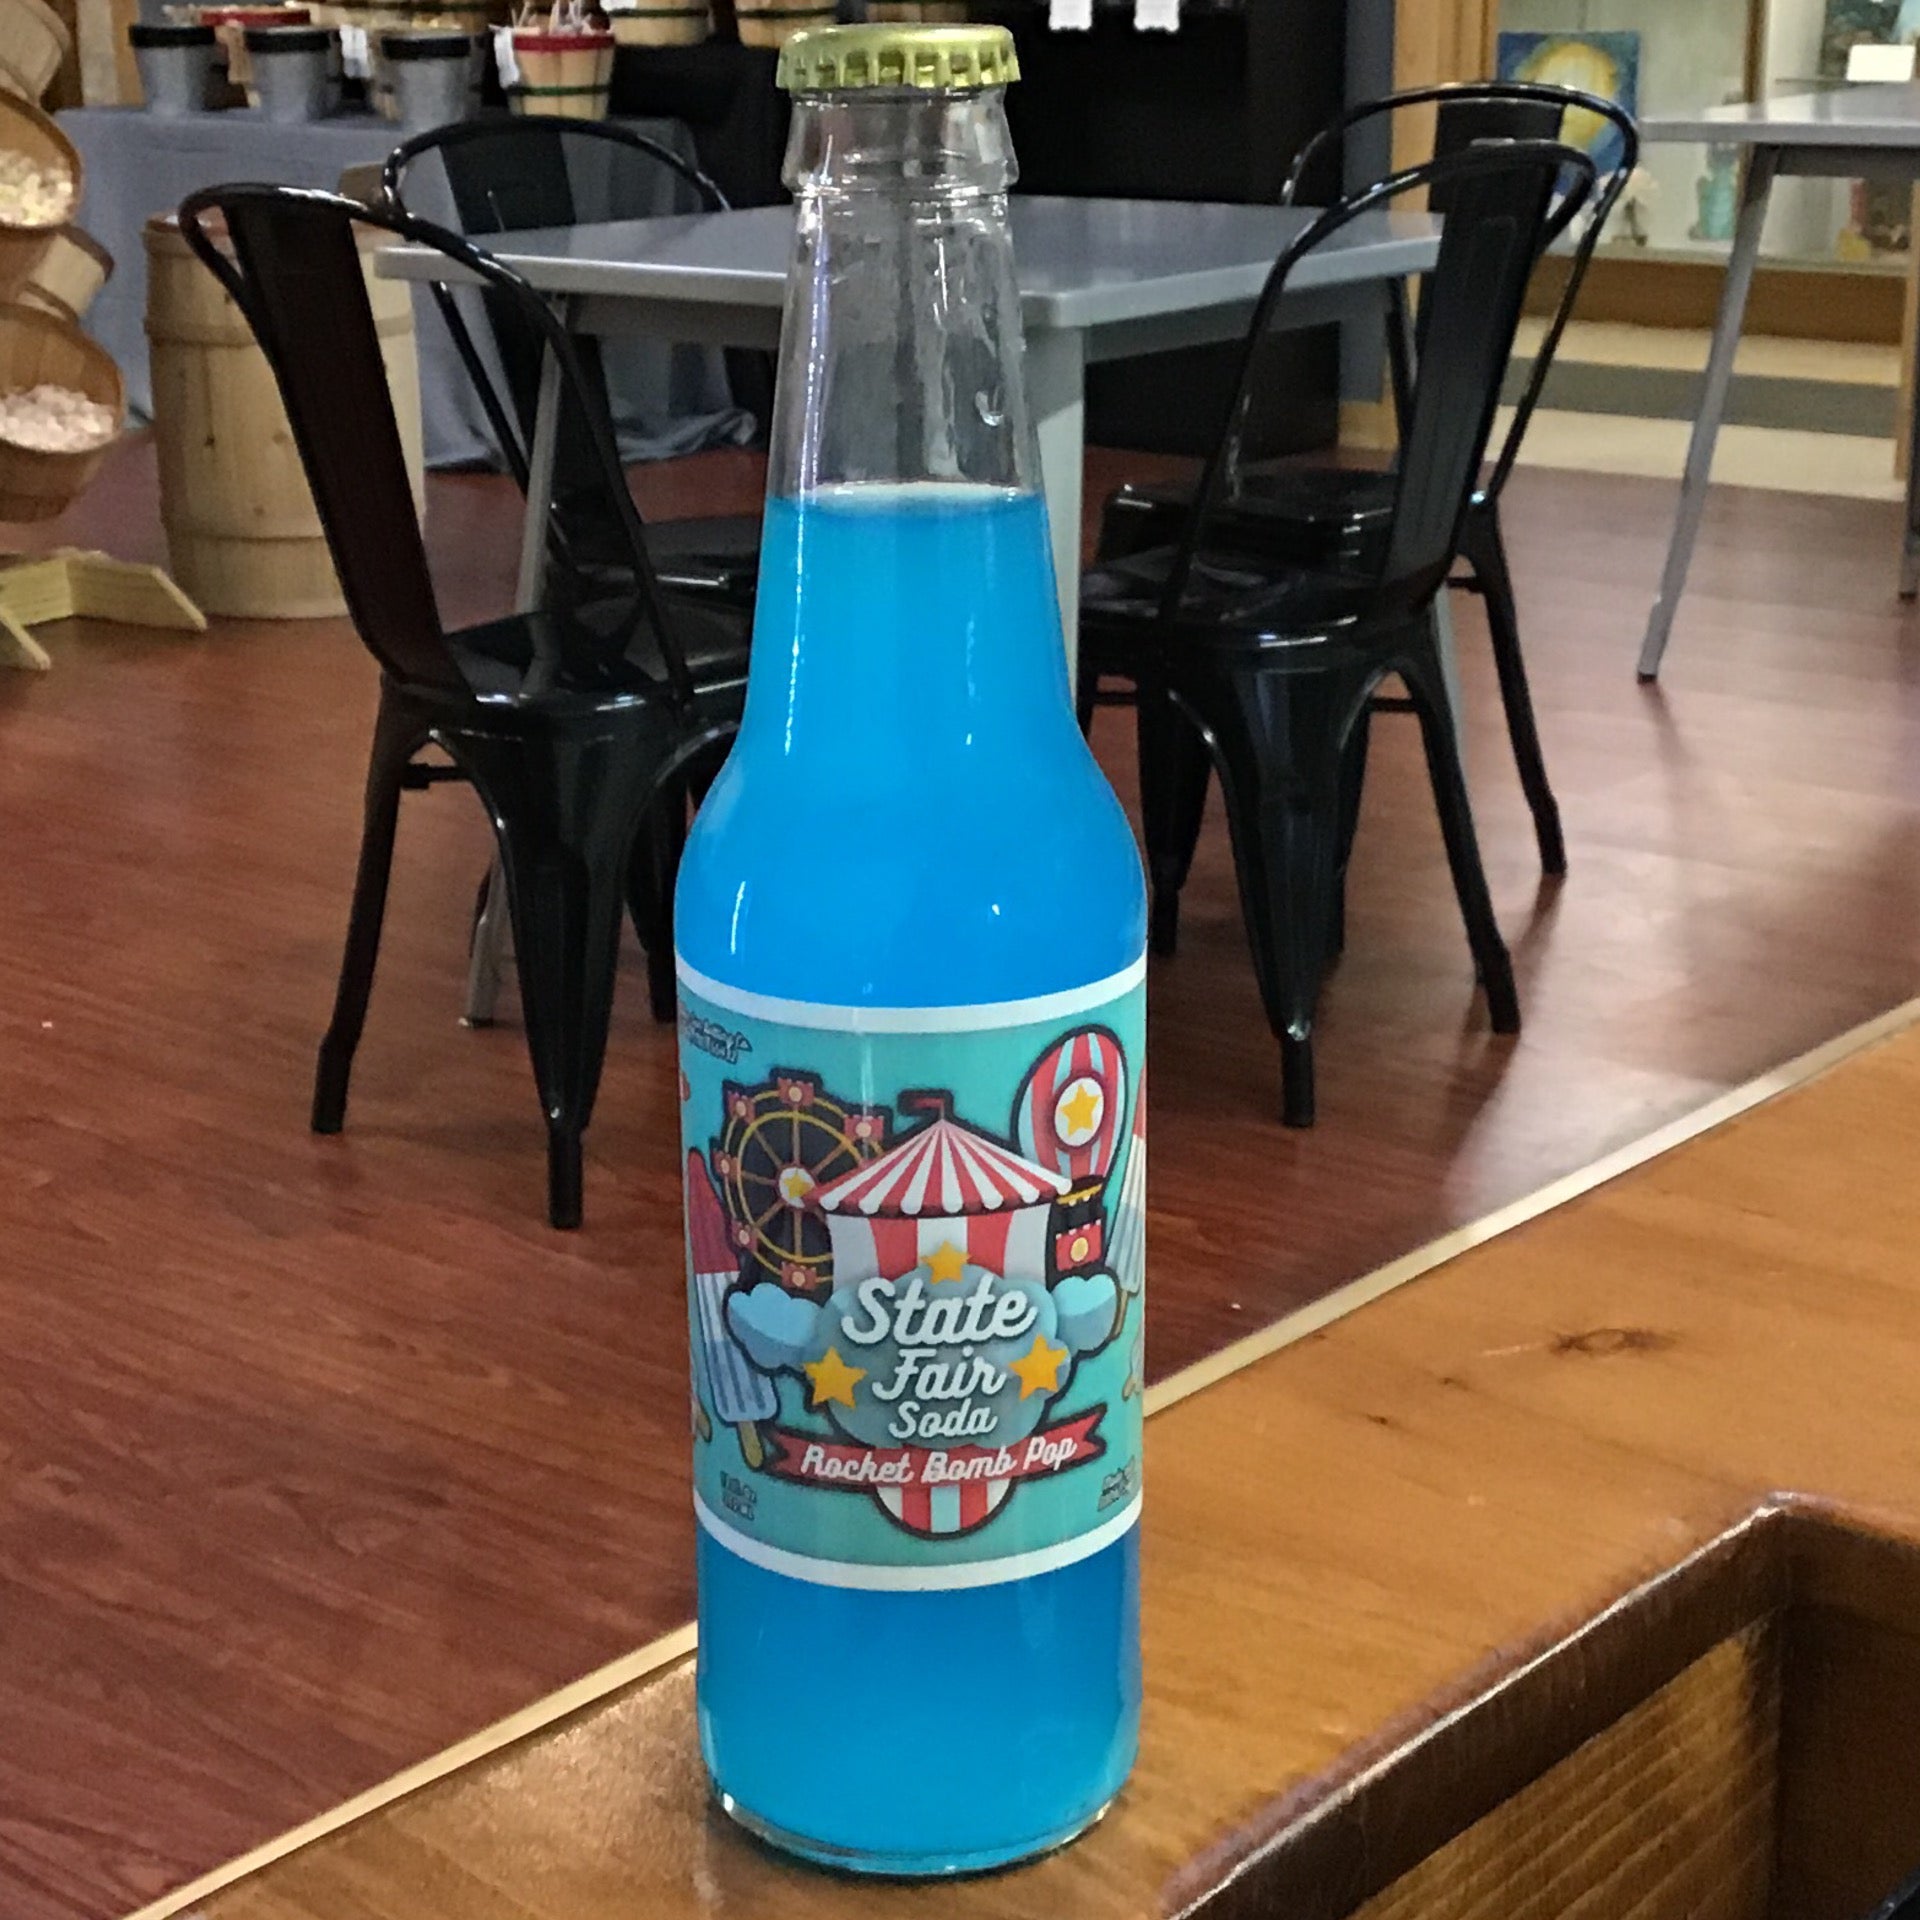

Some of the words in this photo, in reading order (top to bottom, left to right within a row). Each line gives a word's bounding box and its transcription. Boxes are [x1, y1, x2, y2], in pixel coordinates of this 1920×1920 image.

[841, 1273, 1038, 1345] State
[872, 1346, 1006, 1400] Fair
[888, 1399, 998, 1438] Soda
[801, 1445, 914, 1483] Rocket
[921, 1447, 1017, 1483] Bomb
[1023, 1436, 1077, 1470] Pop
